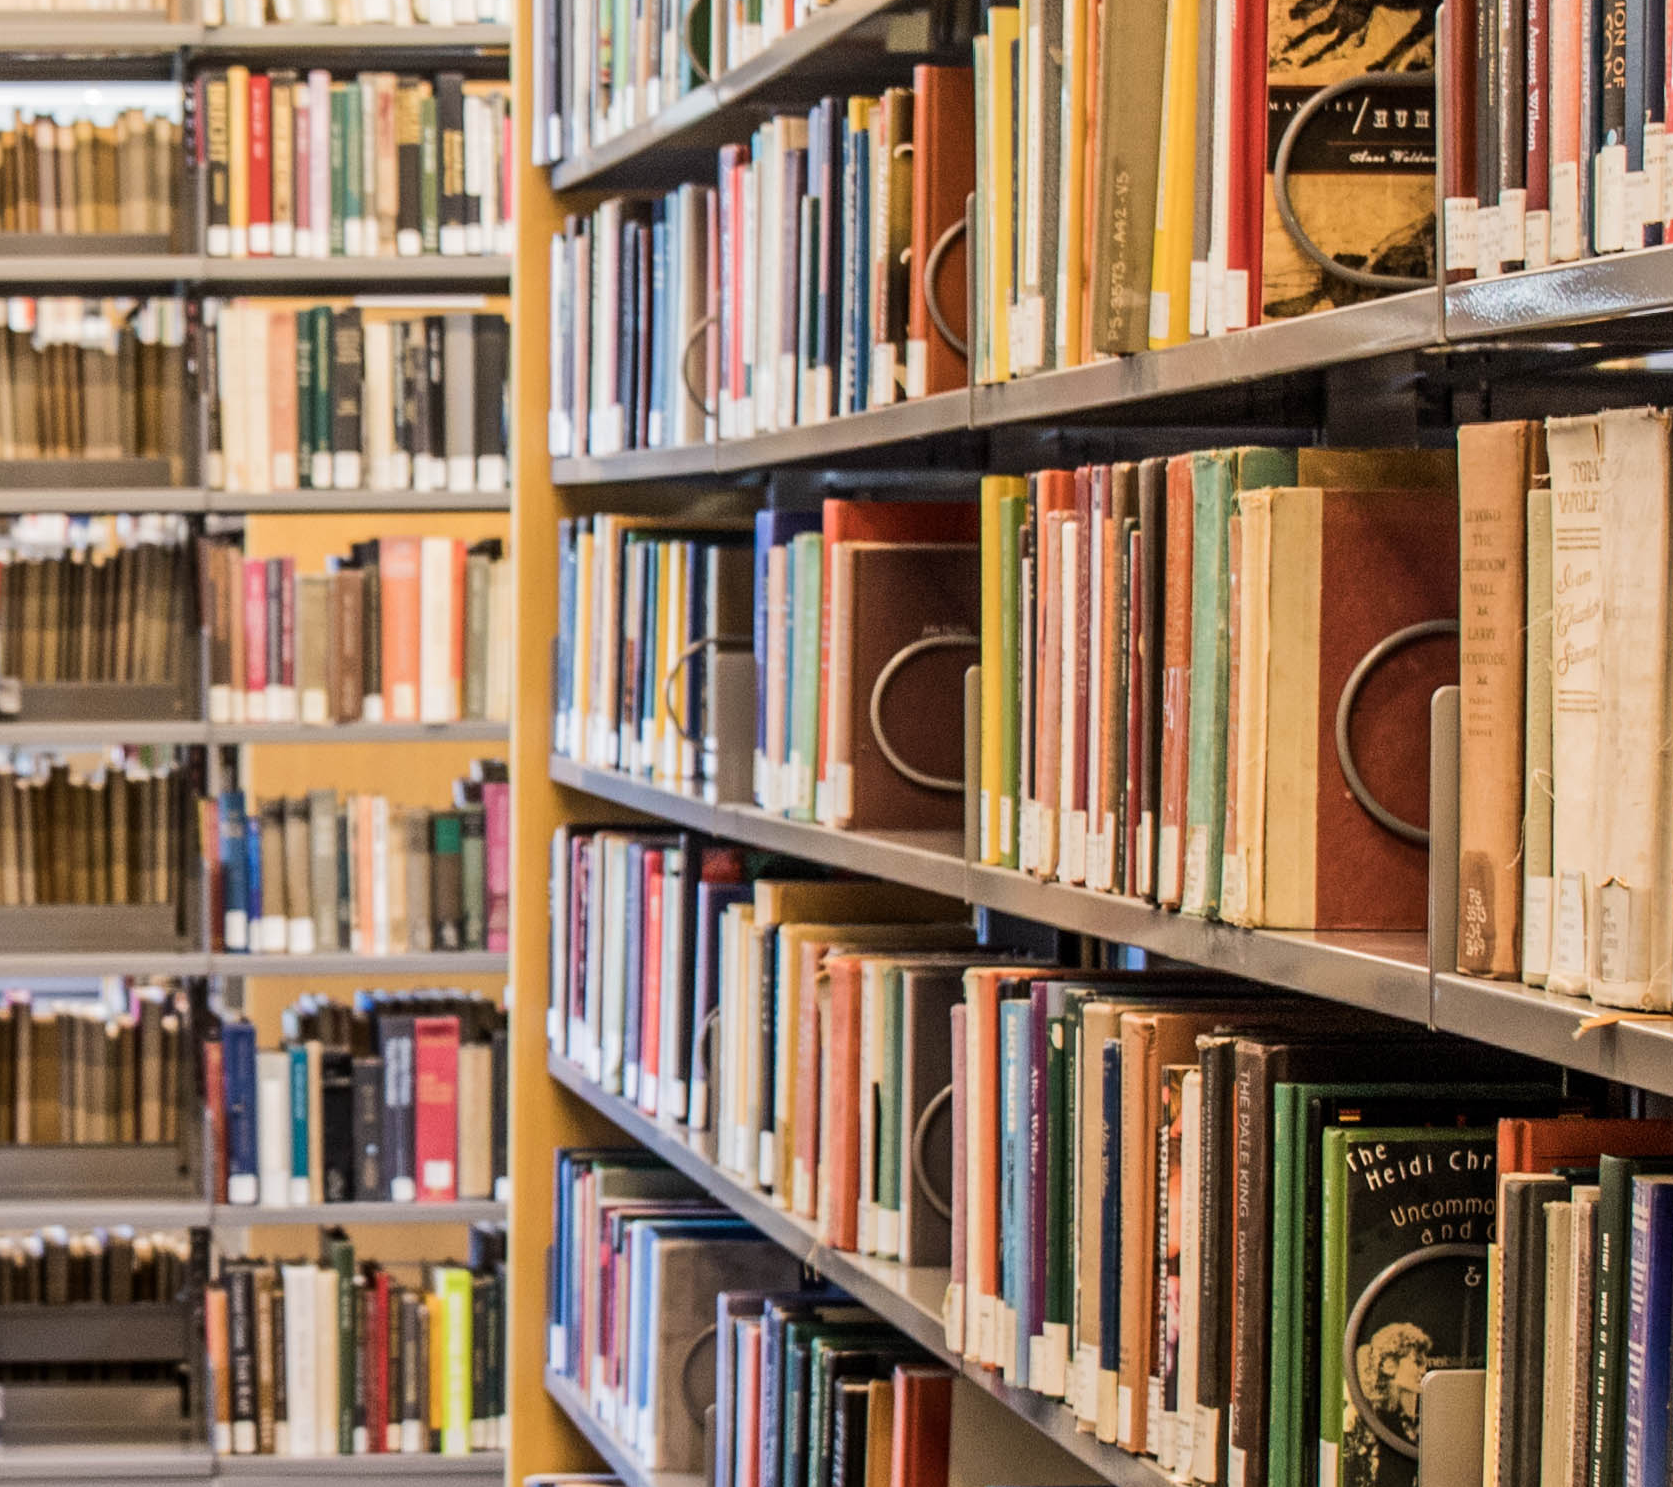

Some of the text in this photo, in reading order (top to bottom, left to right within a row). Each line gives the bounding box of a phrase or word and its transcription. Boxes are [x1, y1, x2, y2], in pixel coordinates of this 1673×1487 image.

[1527, 25, 1540, 85] August
[1610, 55, 1625, 88] OF
[1527, 88, 1540, 152] Wilson
[1238, 1071, 1251, 1218] THE PALE KING
[1232, 1231, 1247, 1436] DAVID FOSTER WALLACE
